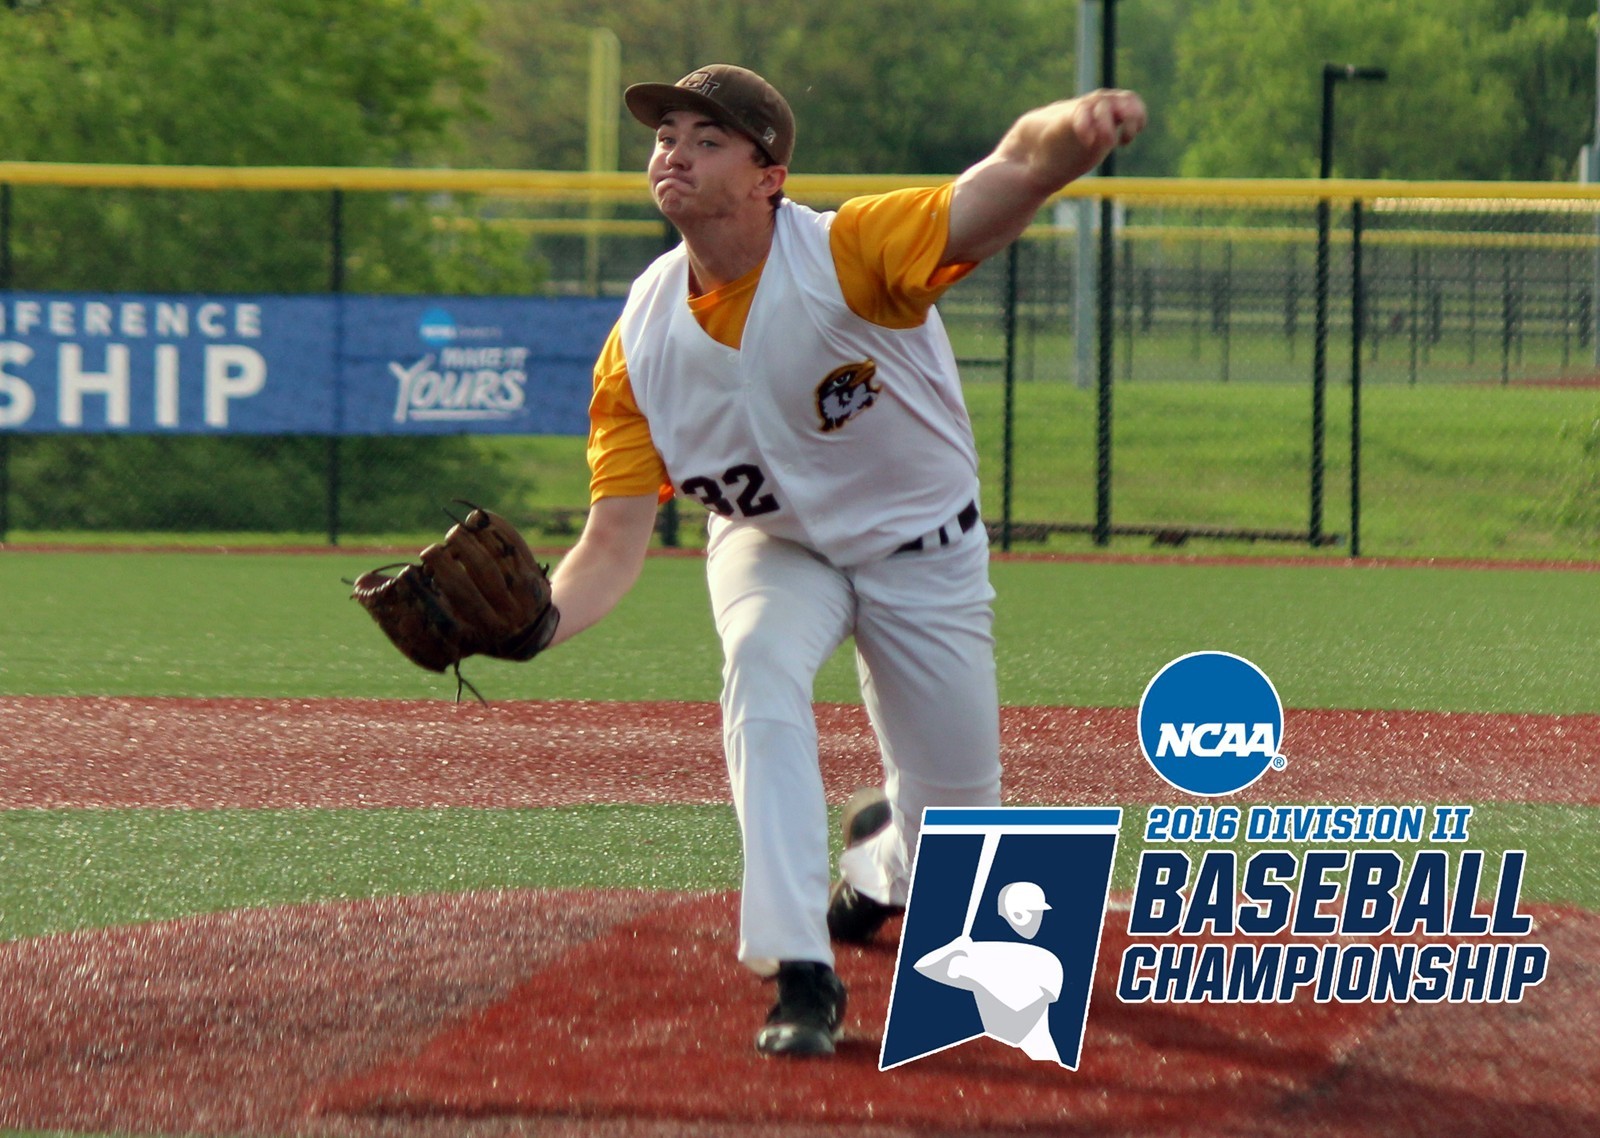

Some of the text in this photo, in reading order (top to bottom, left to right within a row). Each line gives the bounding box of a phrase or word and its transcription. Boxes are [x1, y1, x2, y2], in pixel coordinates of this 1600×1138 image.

[0, 300, 262, 338] FERENCE
[388, 354, 528, 424] YOURS
[681, 464, 780, 517] 32
